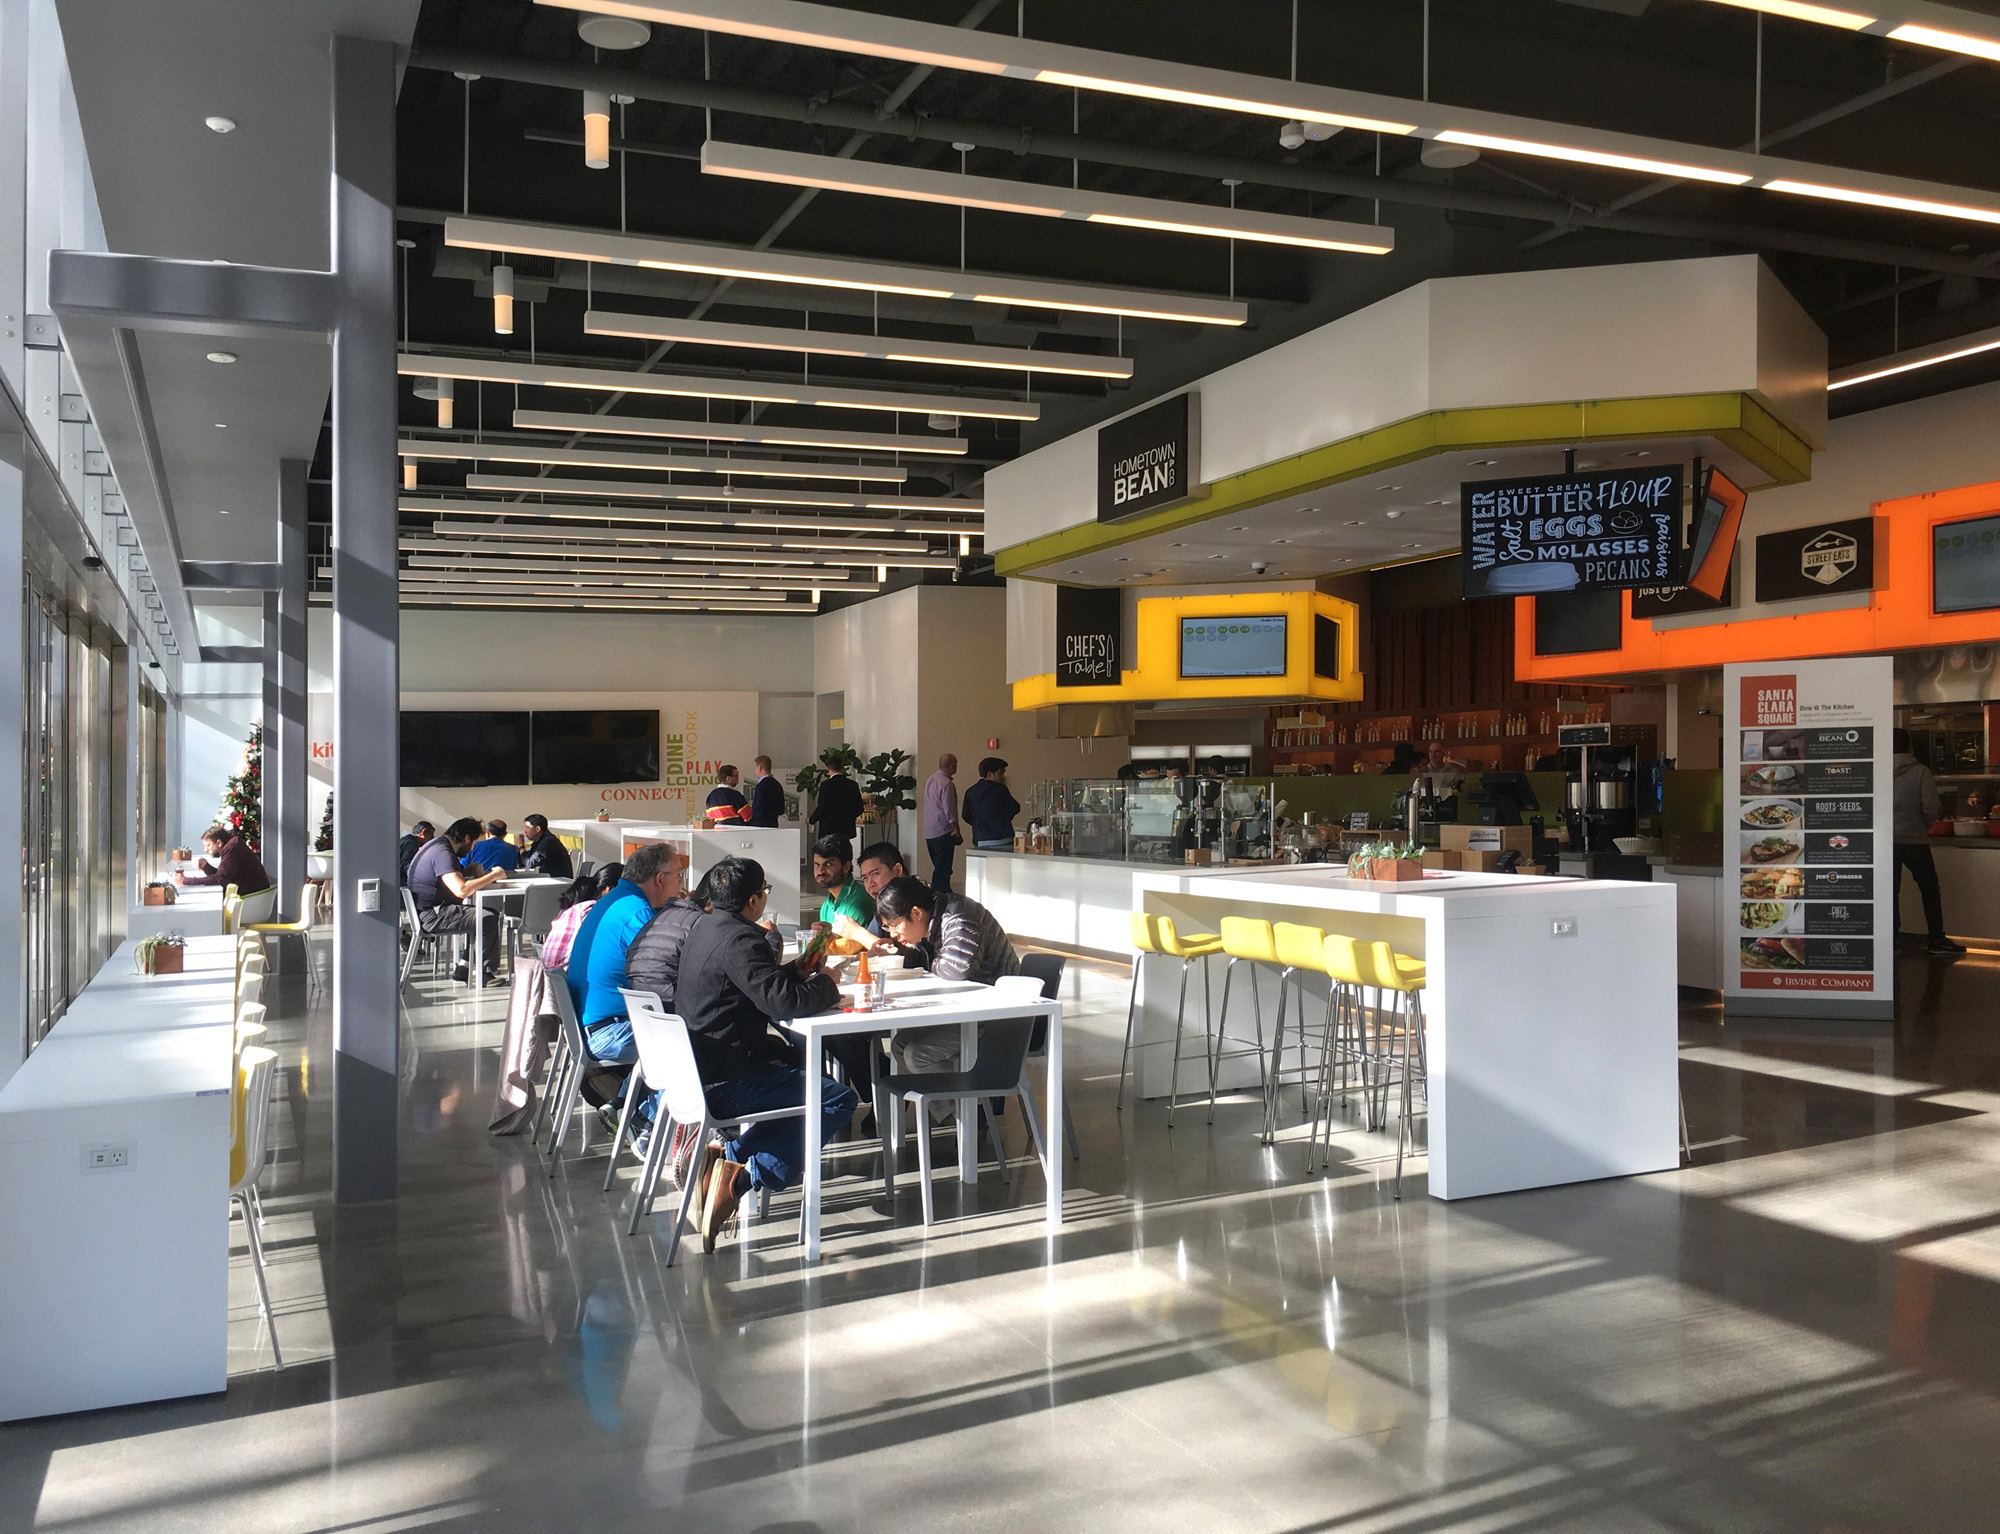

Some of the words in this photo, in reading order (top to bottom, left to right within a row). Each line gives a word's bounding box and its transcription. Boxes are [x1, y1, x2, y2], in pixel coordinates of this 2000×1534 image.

[1113, 461, 1169, 506] BEAN
[1498, 486, 1540, 496] SWEET
[1547, 482, 1591, 492] CREAM
[1596, 476, 1672, 509] FLOUR
[1497, 490, 1593, 518] BUTTER
[1471, 490, 1496, 570] WATER
[1529, 514, 1604, 541] EGGS
[1498, 519, 1535, 561] Salt
[1650, 513, 1671, 579] raisins
[1807, 551, 1832, 565] STREET
[1833, 549, 1851, 561] EATS
[1585, 558, 1651, 582] PECANS
[1066, 634, 1106, 658] CHEF'S
[1059, 657, 1106, 679] Table
[1757, 688, 1794, 701] SANTA
[1757, 700, 1794, 713] CLARA
[1757, 713, 1794, 725] SQUARE
[686, 710, 698, 759] WORK
[666, 733, 684, 775] DINE
[686, 760, 722, 775] PLAY
[666, 775, 721, 786] LOUN
[601, 787, 686, 801] CONNECT
[1785, 977, 1818, 986] IRVINE
[1820, 977, 1871, 988] COMPANY
